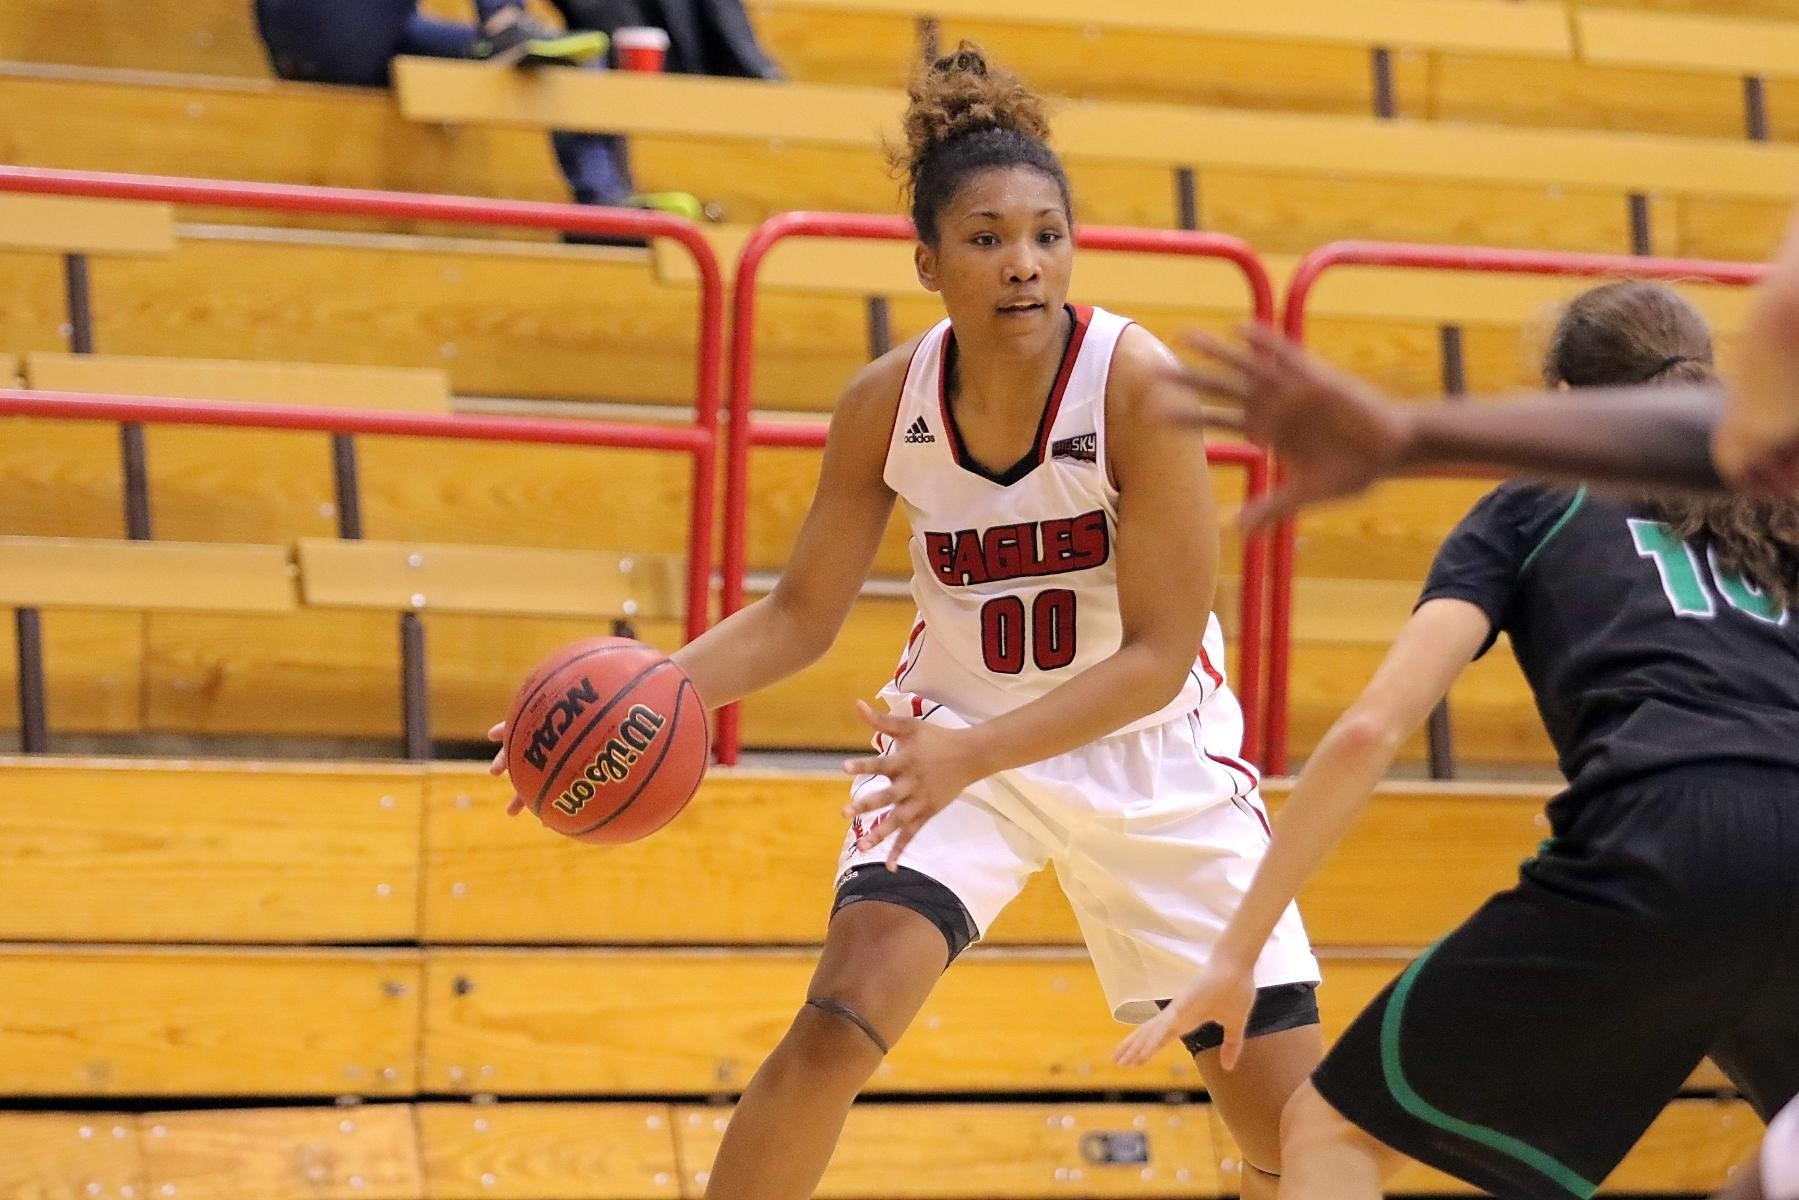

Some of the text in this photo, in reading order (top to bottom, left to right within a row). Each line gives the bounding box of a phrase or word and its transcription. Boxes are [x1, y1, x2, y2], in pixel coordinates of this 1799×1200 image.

[904, 433, 935, 443] adidas
[924, 509, 1110, 587] EAGLES
[980, 588, 1077, 675] 00
[523, 677, 599, 772] NCAA
[552, 704, 666, 817] Wilson
